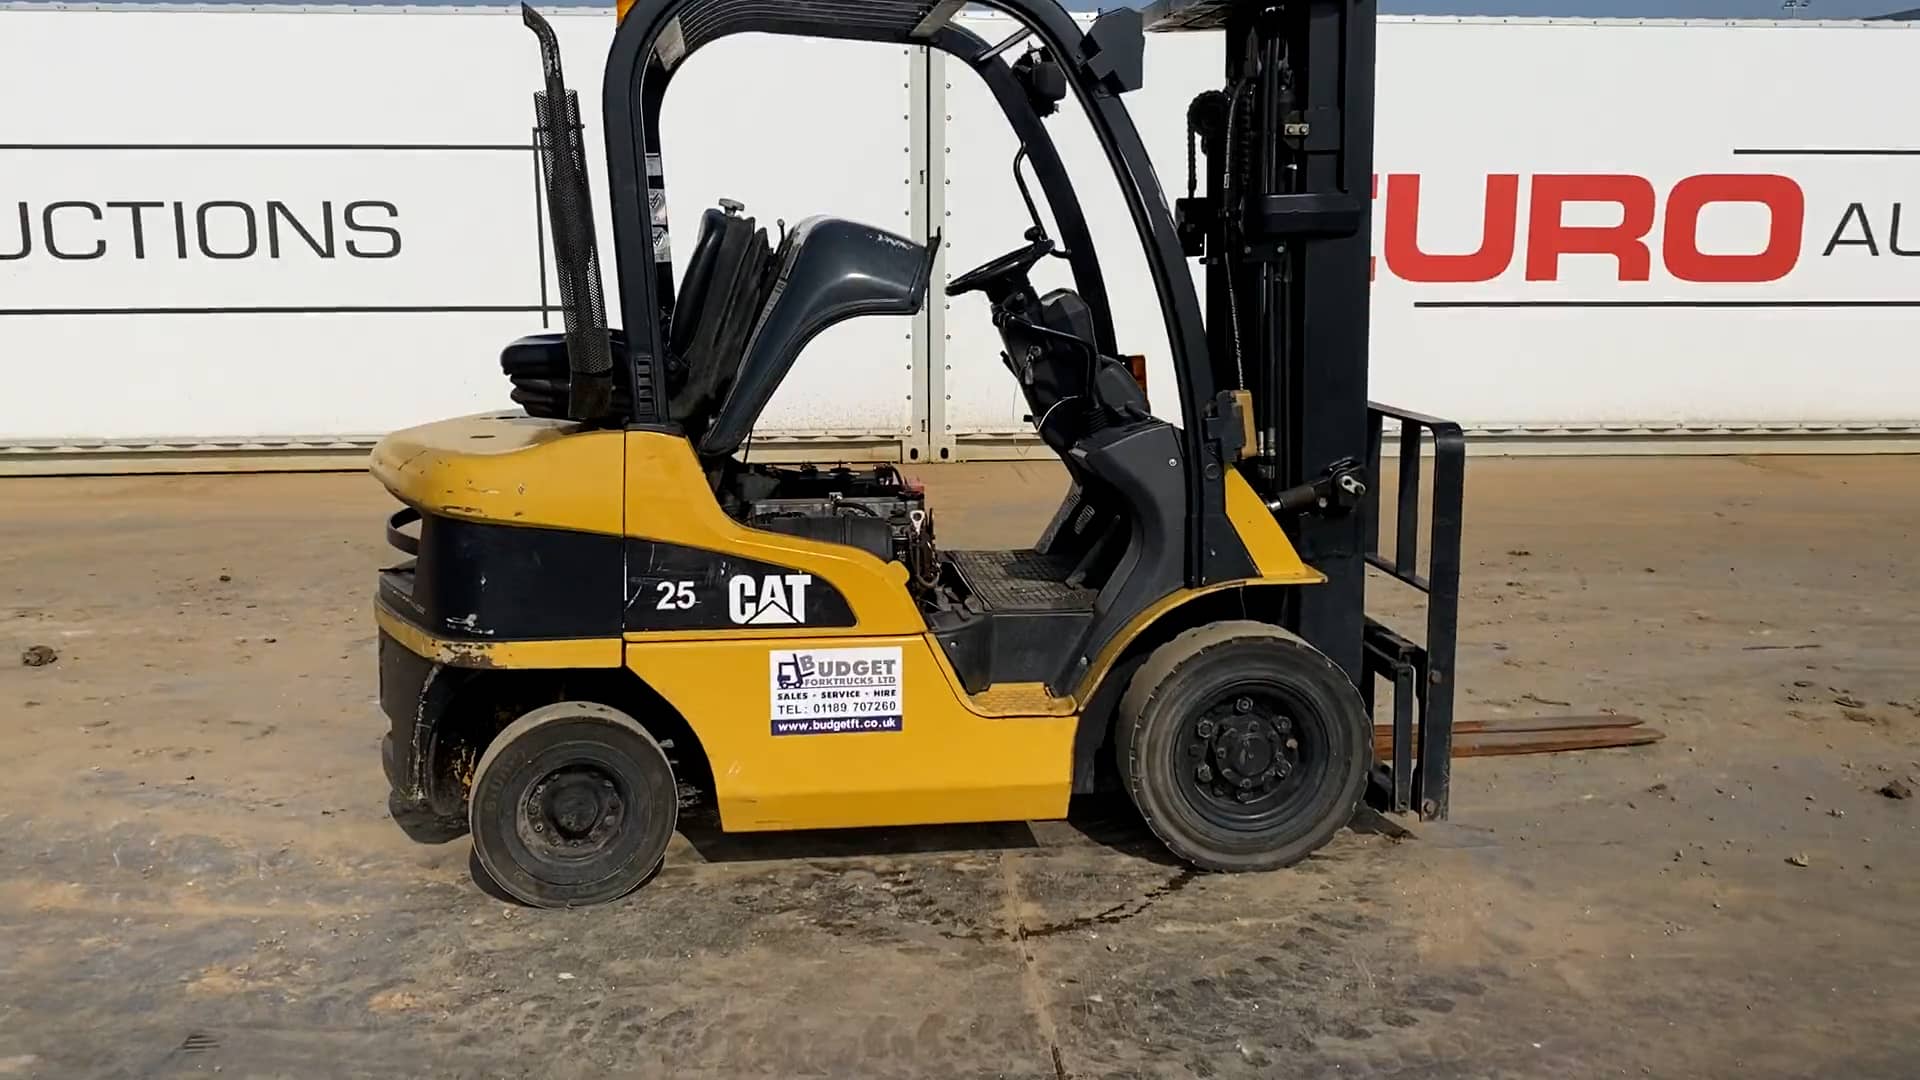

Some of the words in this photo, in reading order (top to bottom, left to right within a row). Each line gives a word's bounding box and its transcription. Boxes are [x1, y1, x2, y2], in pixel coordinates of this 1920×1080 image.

[1371, 173, 1804, 283] URO
[656, 581, 696, 610] 25
[729, 574, 812, 625] CAT
[800, 654, 896, 677] BUDGET
[804, 677, 873, 686] FORKTRUCKS
[878, 676, 896, 684] LTD
[777, 692, 808, 701] SALES
[821, 690, 860, 699] SERVICE
[874, 689, 896, 697] HIRE
[813, 703, 847, 713] 01189
[853, 701, 896, 712] 707260
[778, 717, 896, 732] www.budgetft.co.uk
